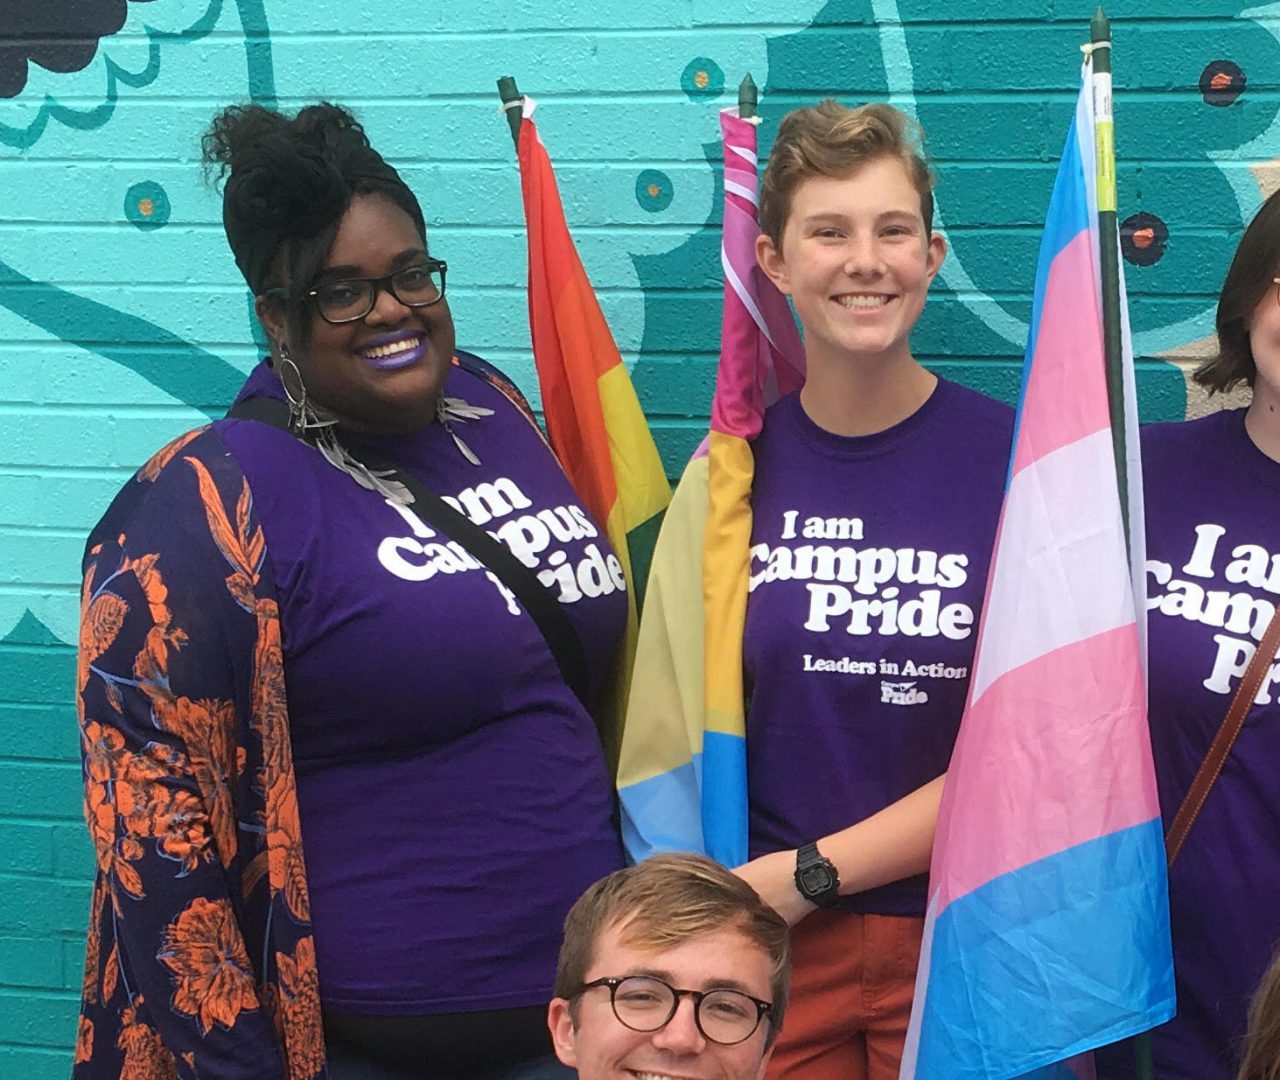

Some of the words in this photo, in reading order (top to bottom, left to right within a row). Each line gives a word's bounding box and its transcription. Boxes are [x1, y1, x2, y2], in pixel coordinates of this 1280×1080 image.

[440, 477, 532, 525] m
[781, 510, 799, 539] I
[802, 516, 864, 540] am
[1182, 524, 1226, 577] I
[485, 543, 627, 616] ide
[804, 583, 974, 640] Pride
[803, 655, 876, 675] Leaders
[879, 659, 899, 676] in
[901, 660, 968, 679] Action
